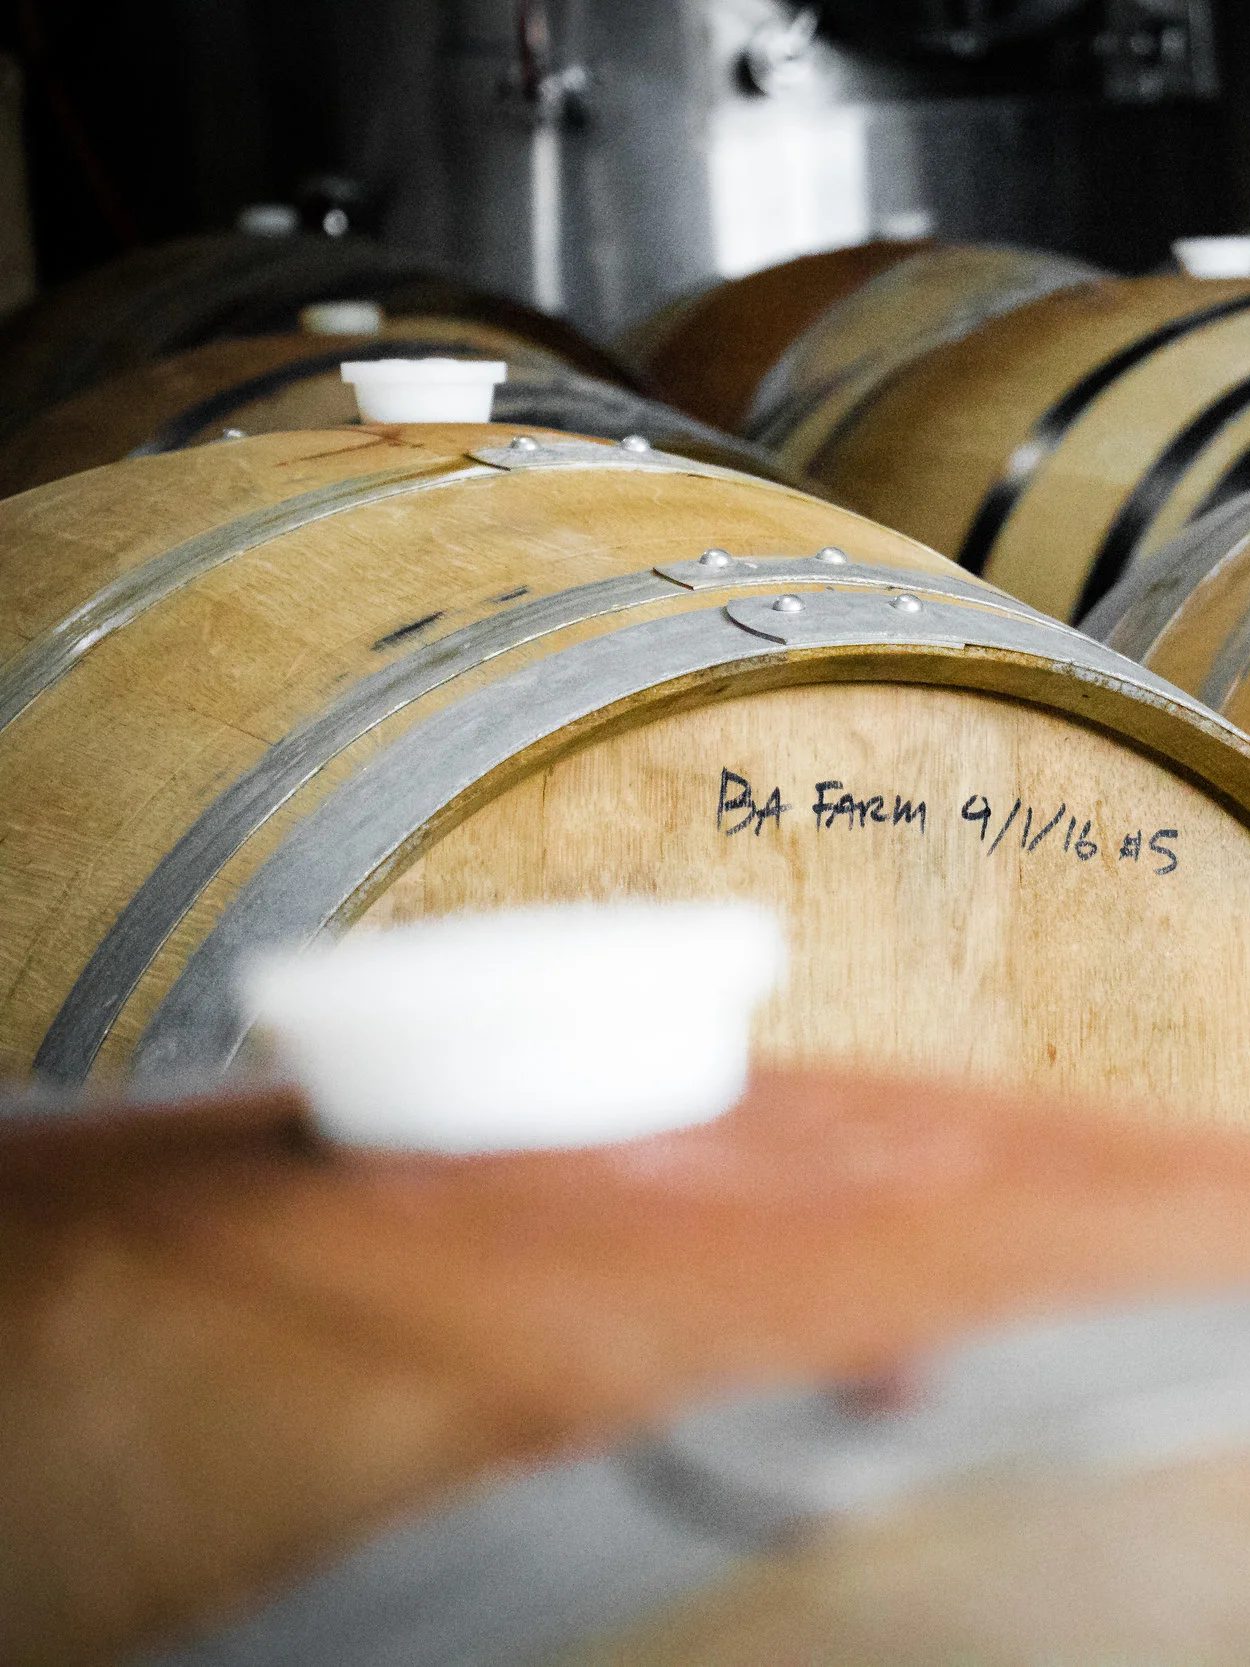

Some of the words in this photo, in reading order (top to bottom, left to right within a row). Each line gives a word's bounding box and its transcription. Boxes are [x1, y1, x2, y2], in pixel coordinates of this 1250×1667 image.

[717, 766, 792, 836] BA
[812, 780, 927, 835] FARM
[960, 795, 1098, 861] 9/1/16
[1119, 829, 1180, 875] #5
